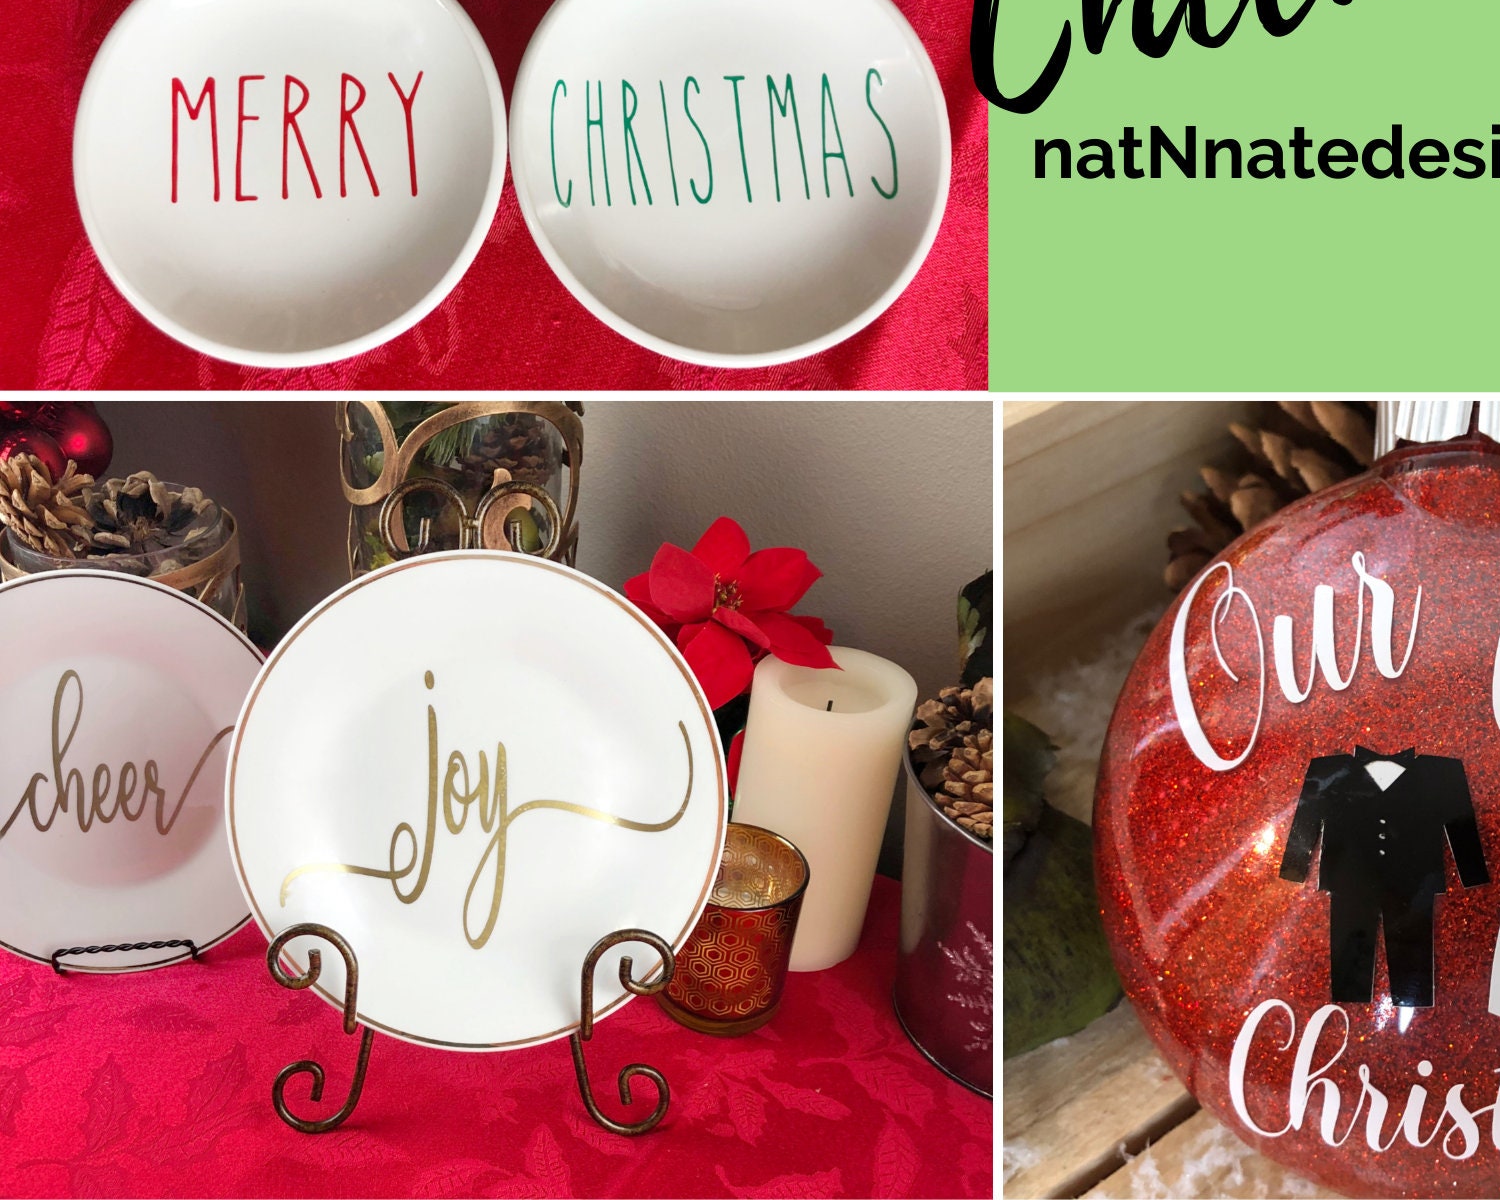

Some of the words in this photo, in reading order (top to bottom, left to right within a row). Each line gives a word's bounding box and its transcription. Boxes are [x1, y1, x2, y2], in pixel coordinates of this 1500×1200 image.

[171, 70, 424, 203] MERRY
[549, 68, 898, 209] CHRISTMAS
[1169, 551, 1423, 771] Our
[0, 669, 235, 839] cheer
[279, 670, 694, 950] joy
